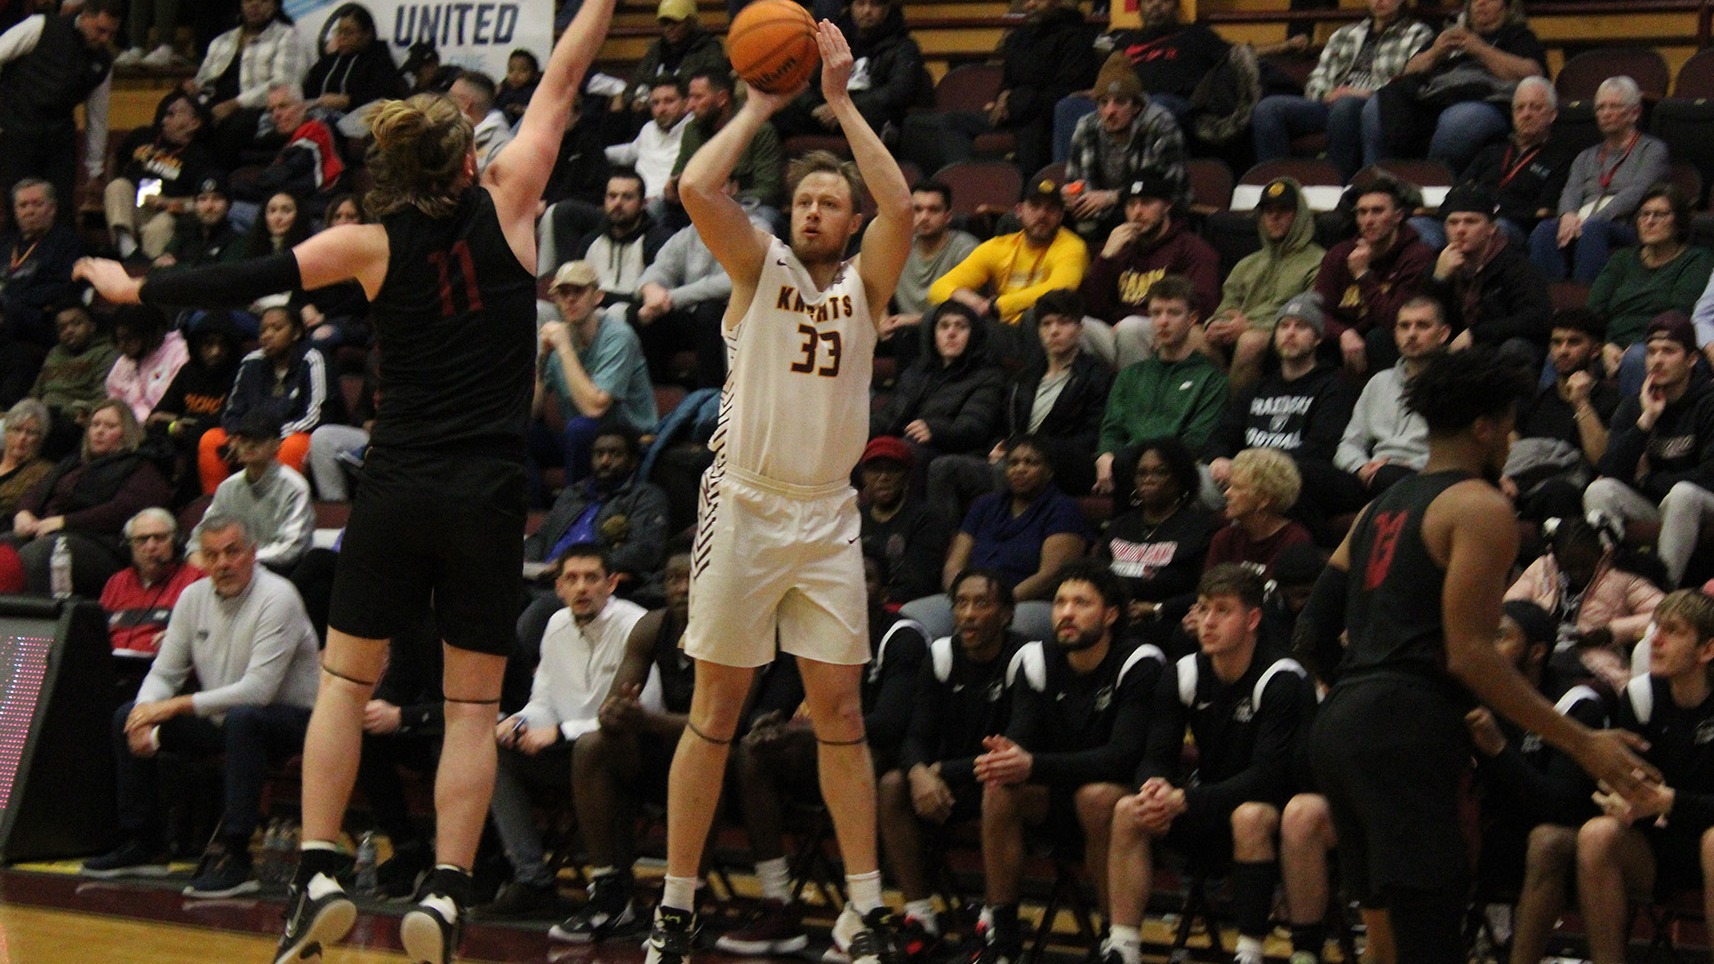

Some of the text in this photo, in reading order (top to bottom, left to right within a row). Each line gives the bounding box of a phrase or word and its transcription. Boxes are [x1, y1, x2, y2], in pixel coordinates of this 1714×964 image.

[395, 4, 518, 46] UNITED
[427, 240, 485, 316] 11
[791, 323, 841, 377] 33
